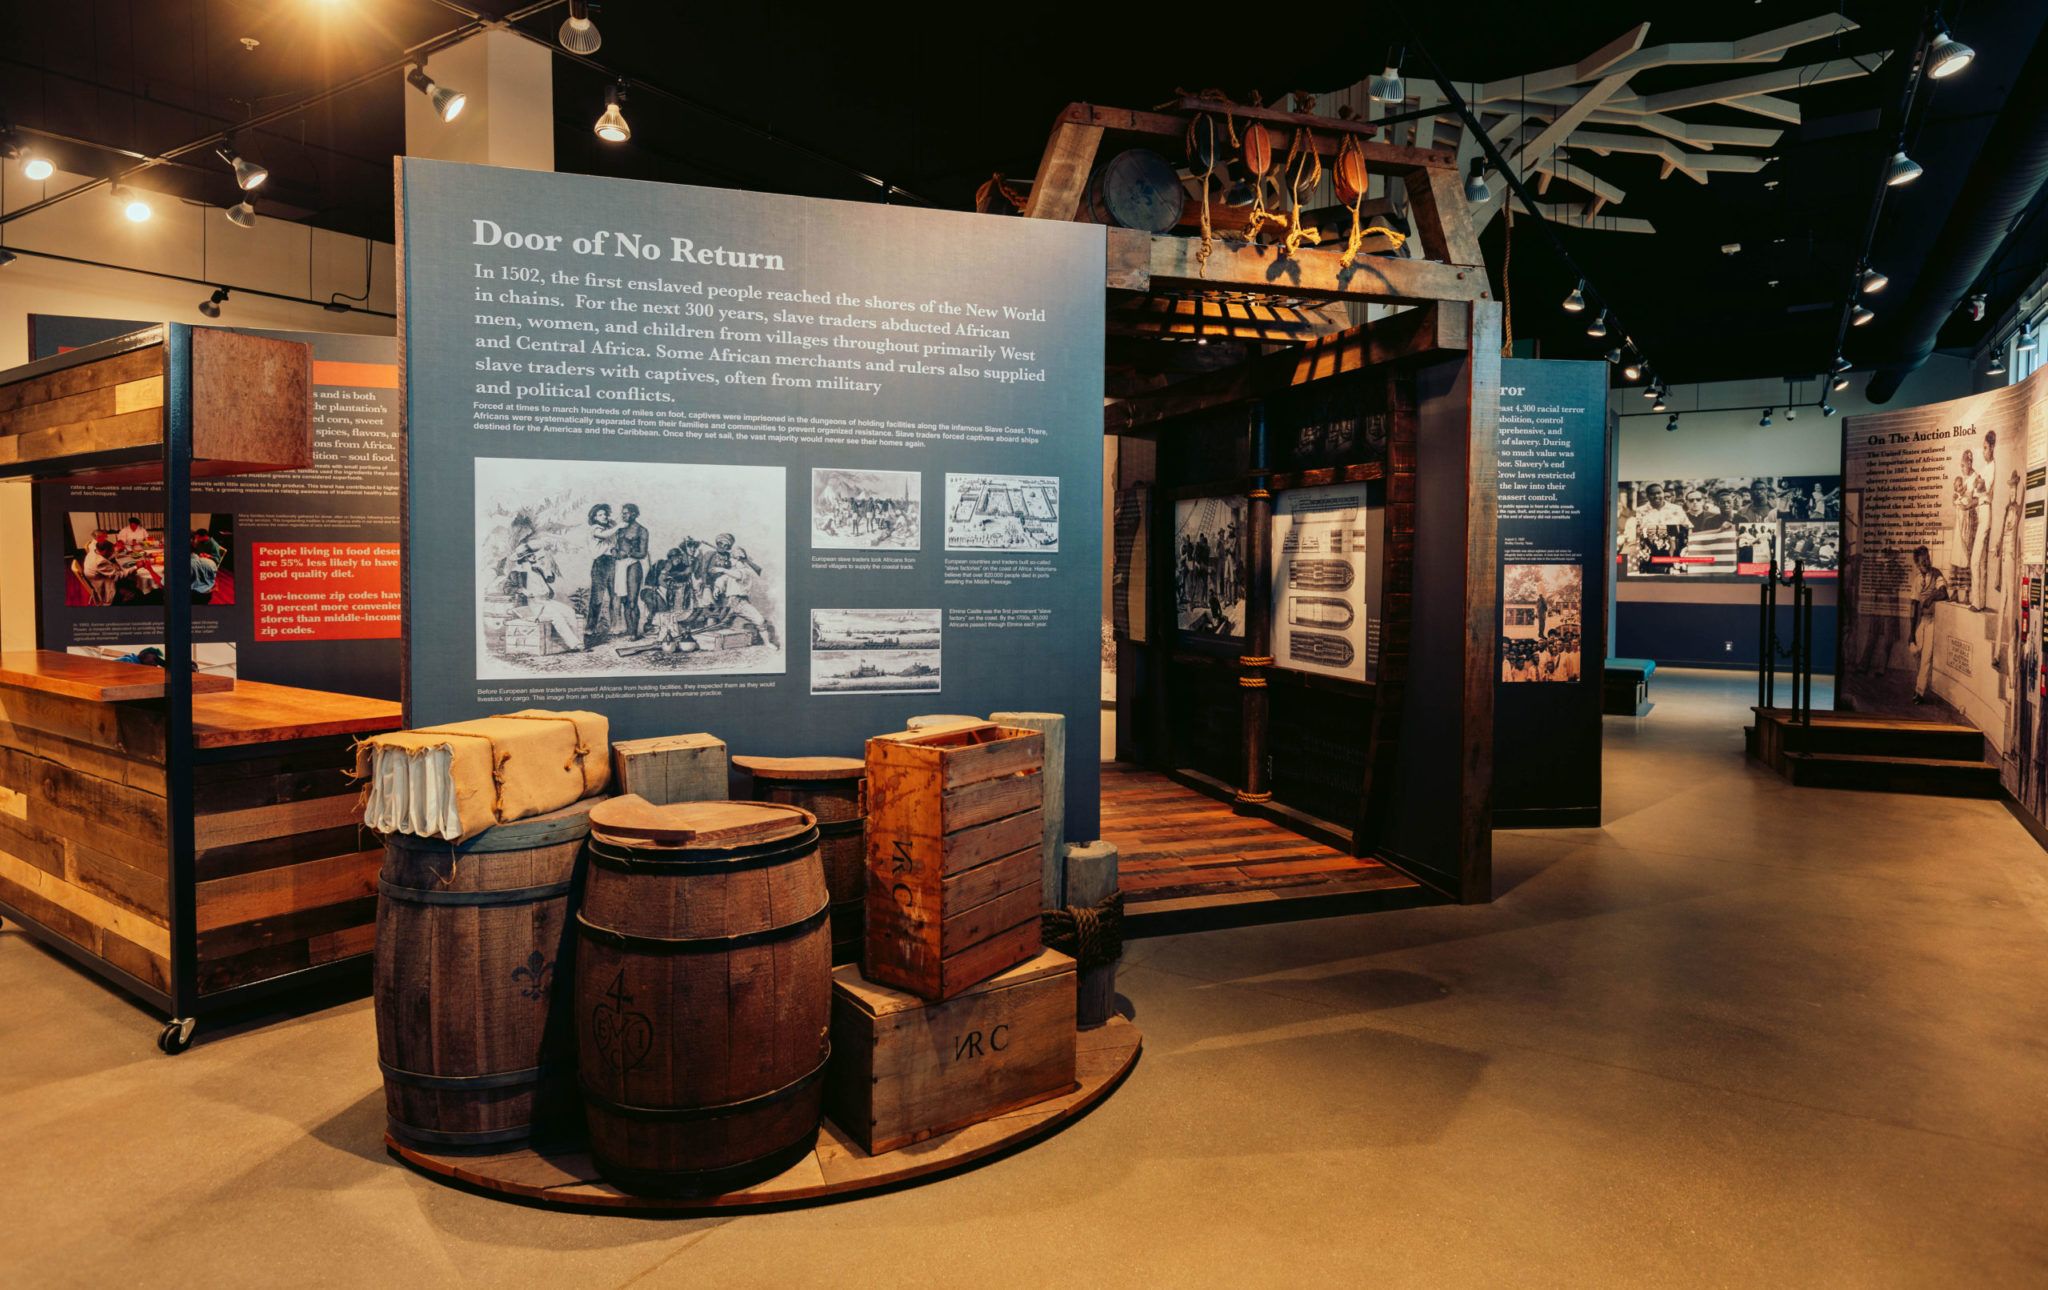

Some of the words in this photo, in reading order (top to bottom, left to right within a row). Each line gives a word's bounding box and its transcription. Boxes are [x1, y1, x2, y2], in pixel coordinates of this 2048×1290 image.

[472, 219, 562, 251] Door
[572, 230, 610, 255] of
[614, 231, 660, 260] No
[670, 236, 785, 271] Return
[474, 263, 495, 278] In
[501, 265, 545, 285] 1502,
[550, 270, 579, 285] the
[584, 272, 622, 288] first
[627, 277, 703, 294] enslaved
[707, 284, 762, 301] people
[766, 289, 831, 304] reached
[836, 292, 860, 307] the
[864, 295, 915, 311] shores
[919, 299, 936, 313] of
[938, 300, 962, 315] the
[965, 302, 998, 318] New
[1002, 305, 1046, 322] World
[474, 286, 494, 302] in
[498, 289, 564, 307] chains.
[575, 293, 606, 309] For
[609, 297, 638, 312] the
[642, 303, 680, 315] next
[684, 302, 714, 317] 300
[718, 309, 768, 324] years,
[772, 308, 814, 324] slave
[818, 313, 876, 329] traders
[880, 317, 951, 334] abducted
[954, 322, 1010, 339] African
[474, 314, 522, 329] men,
[526, 318, 599, 334] women,
[604, 320, 638, 334] and
[642, 321, 714, 339] children
[719, 326, 761, 342] from
[765, 329, 828, 349] villages
[832, 334, 919, 354] throughout
[922, 341, 996, 362] primarily
[1000, 345, 1035, 361] West
[475, 335, 510, 349] and
[516, 336, 585, 353] Central
[590, 341, 650, 357] Africa.
[656, 344, 704, 360] Some
[708, 348, 771, 364] African
[775, 354, 861, 369] merchants
[865, 358, 895, 372] and
[898, 360, 945, 375] rulers
[948, 363, 980, 377] also
[983, 367, 1045, 383] supplied
[475, 356, 522, 372] slave
[527, 360, 594, 376] traders
[599, 363, 640, 378] with
[644, 367, 719, 385] captives,
[724, 370, 766, 385] often
[771, 372, 812, 387] from
[816, 375, 882, 395] military
[320, 390, 340, 398] and
[342, 390, 351, 399] is
[352, 391, 376, 400] both
[475, 381, 511, 394] and
[516, 382, 590, 399] political
[596, 386, 675, 402] conflicts.
[1500, 386, 1525, 396] ror
[314, 402, 327, 410] he
[329, 402, 387, 413] plantation's
[1515, 404, 1536, 413] 4,300
[326, 417, 352, 425] corn,
[1535, 416, 1563, 424] control
[315, 427, 350, 437] spices,
[351, 428, 389, 439] flavors,
[473, 421, 510, 430] destined
[512, 423, 525, 431] for
[526, 424, 540, 432] the
[542, 424, 582, 433] Americas
[584, 426, 600, 434] and
[617, 427, 660, 436] Caribbean.
[662, 429, 684, 437] Once
[685, 430, 702, 439] they
[718, 431, 734, 440] sail,
[735, 432, 748, 440] the
[767, 433, 798, 443] majority
[800, 435, 822, 443] would
[860, 437, 878, 445] their
[878, 438, 903, 446] homes
[904, 440, 926, 448] again.
[1866, 434, 1886, 446] On
[1888, 432, 1910, 444] The
[1912, 428, 1950, 442] Auction
[1952, 423, 1976, 437] Block
[334, 439, 360, 448] from
[362, 440, 396, 449] Africa.
[1501, 436, 1511, 445] of
[1510, 437, 1540, 447] slavery.
[1542, 437, 1570, 448] During
[348, 453, 370, 461] soul
[372, 453, 396, 462] food.
[1535, 449, 1556, 457] value
[1497, 459, 1512, 467] bor.
[1514, 459, 1549, 469] Slavery's
[1550, 460, 1564, 468] end
[1537, 471, 1575, 479] restricted
[1499, 481, 1512, 489] the
[1513, 481, 1528, 489] law
[1529, 481, 1545, 489] into
[1546, 482, 1566, 490] their
[1527, 493, 1557, 501] control.
[259, 546, 297, 558] People
[300, 546, 330, 557] living
[332, 546, 343, 555] in
[346, 546, 370, 555] food
[372, 546, 400, 555] deser
[280, 558, 304, 566] 55%
[306, 558, 327, 567] less
[329, 557, 358, 568] likely
[360, 558, 372, 566] to
[374, 558, 398, 566] have
[259, 569, 287, 580] good
[290, 569, 328, 580] quality
[330, 568, 354, 577] diet.
[260, 591, 326, 600] Low-income
[328, 591, 345, 602] zip
[348, 590, 378, 599] codes
[380, 590, 401, 599] hav
[260, 603, 274, 612] 30
[276, 603, 318, 614] percent
[260, 615, 294, 623] stores
[296, 614, 321, 623] than
[260, 626, 278, 637] zip
[280, 625, 315, 634] codes.
